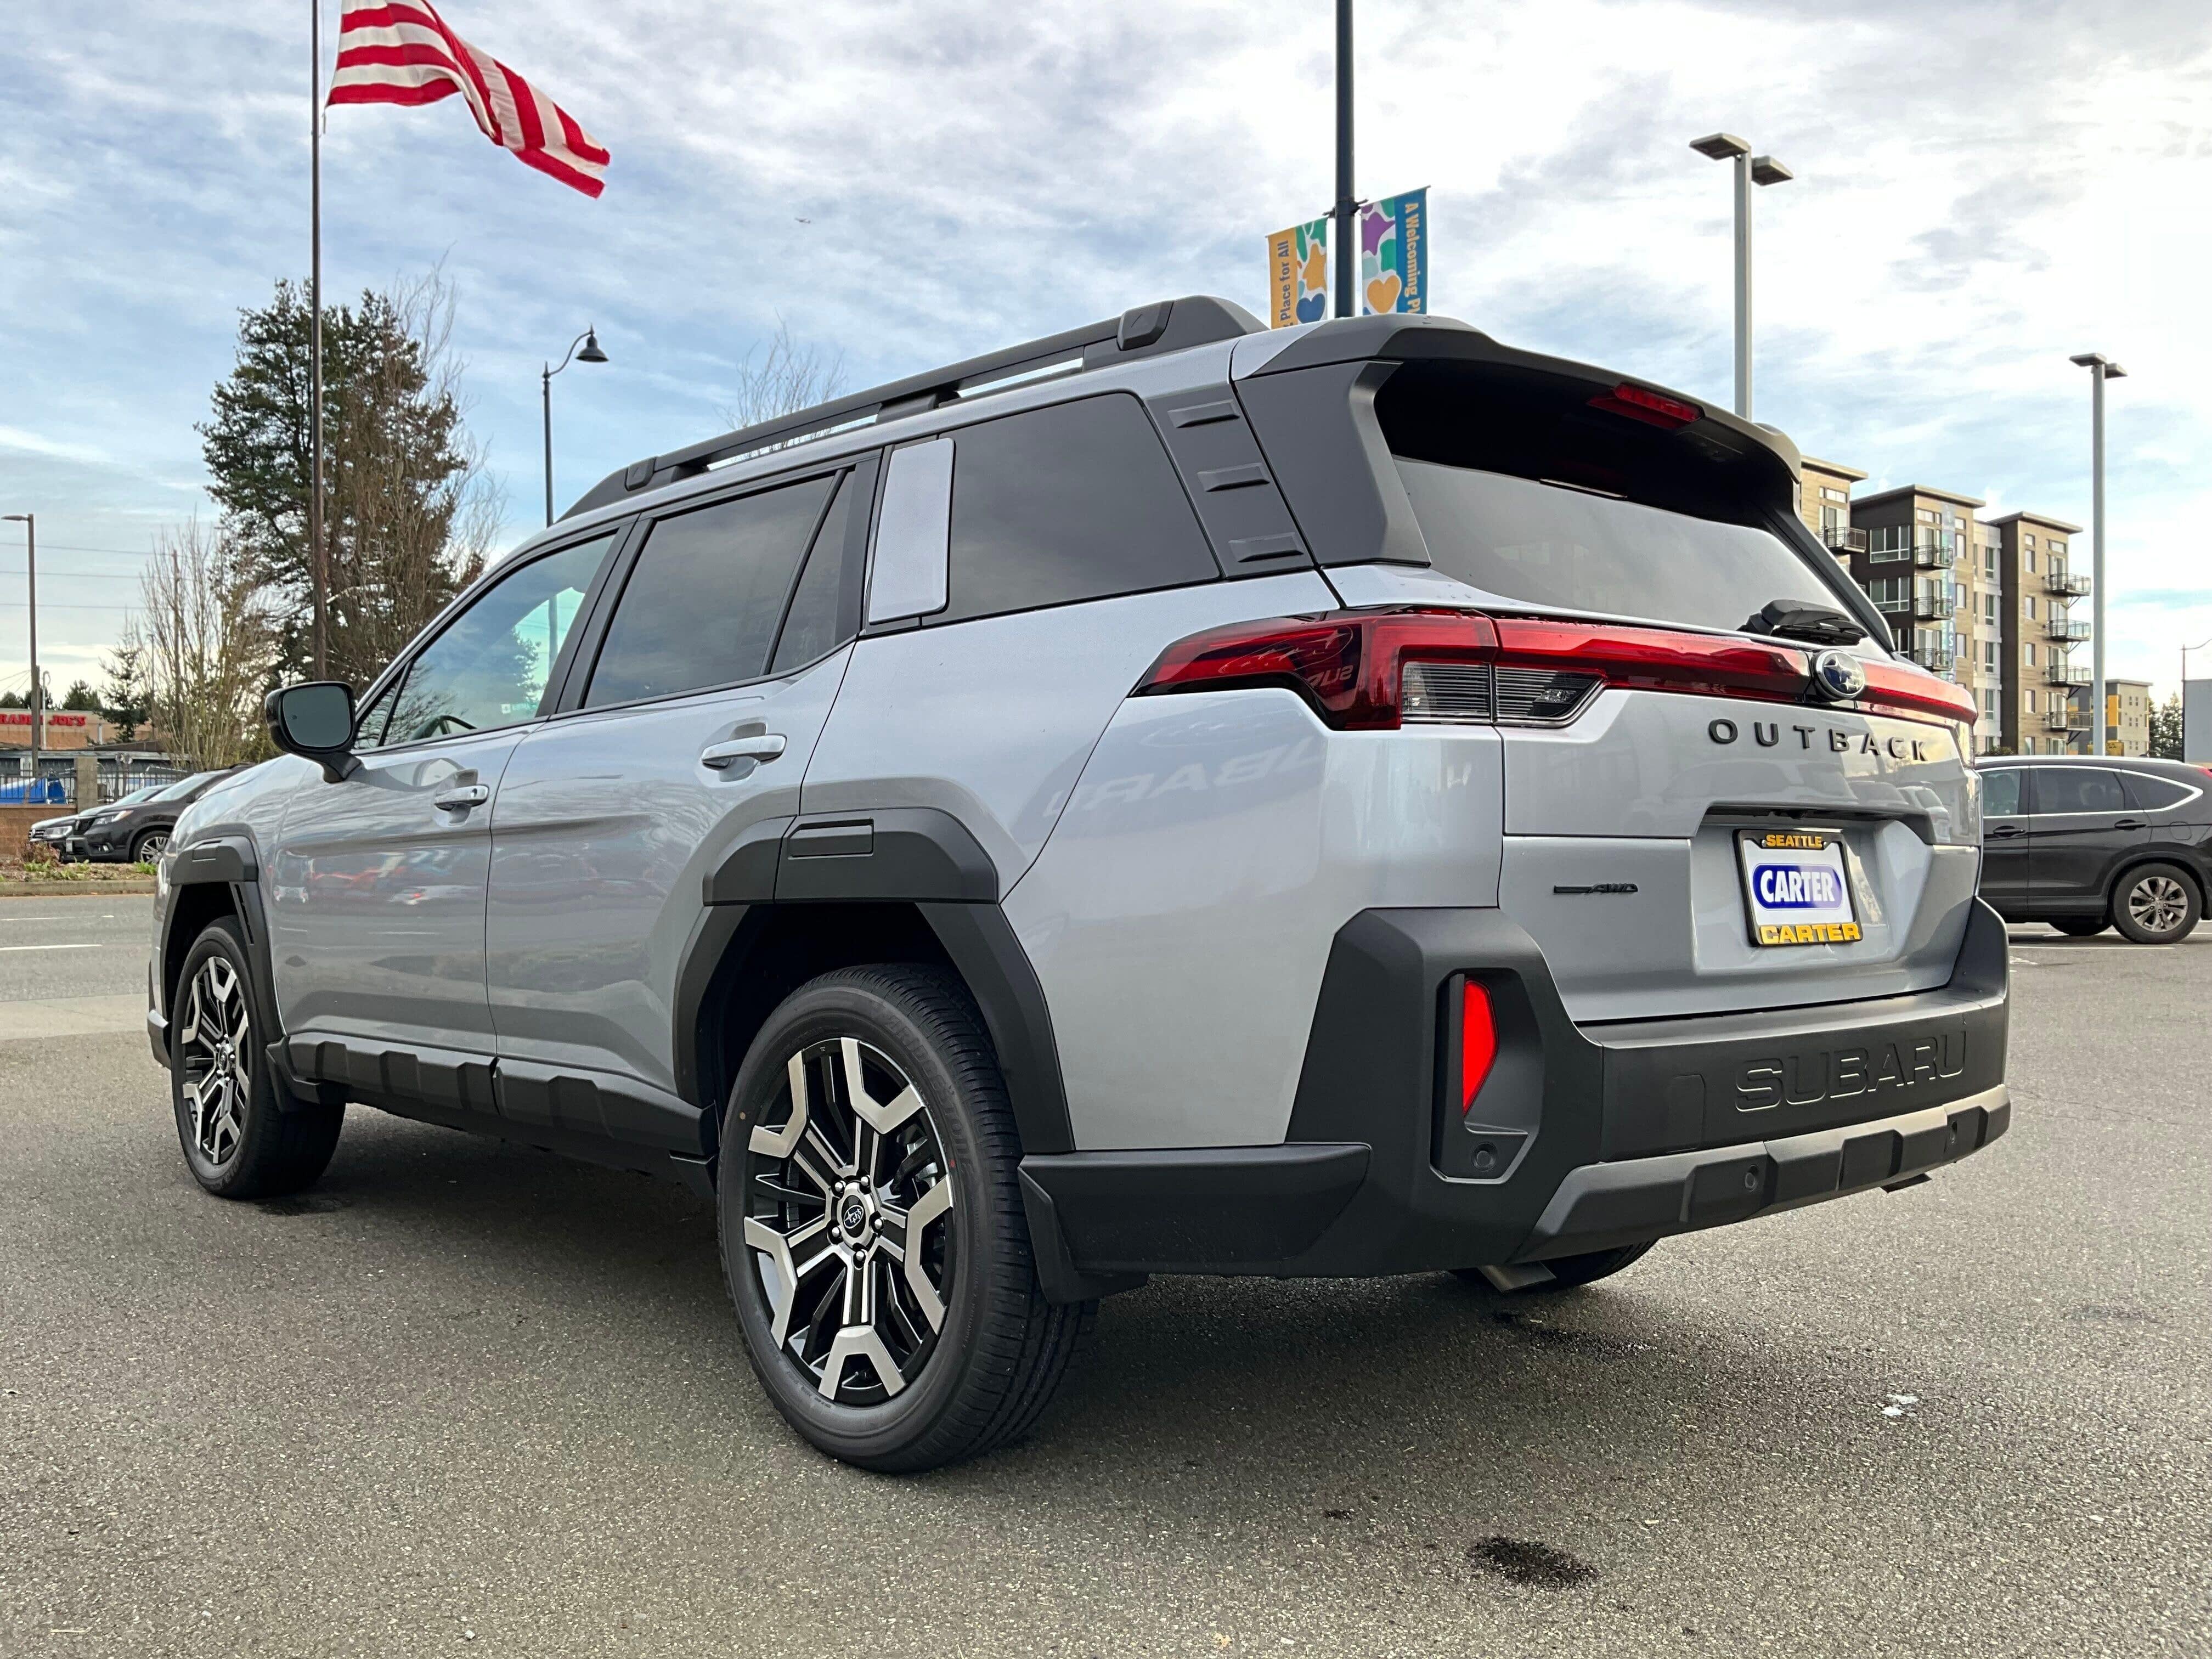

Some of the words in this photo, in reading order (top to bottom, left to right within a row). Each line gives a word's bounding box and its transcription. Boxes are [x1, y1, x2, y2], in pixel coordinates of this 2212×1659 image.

[1405, 202, 1419, 213] A
[1278, 240, 1289, 258] All
[1404, 213, 1420, 297] Welcoming
[1279, 262, 1290, 282] for
[1280, 284, 1291, 321] Place
[1708, 718, 1928, 761] OUTBACK
[1765, 834, 1822, 848] SEATTLE
[1592, 883, 1639, 893] AWD
[1760, 870, 1835, 903] CARTER
[1759, 922, 1861, 944] CARTER
[1735, 1030, 1967, 1113] SUBARU
